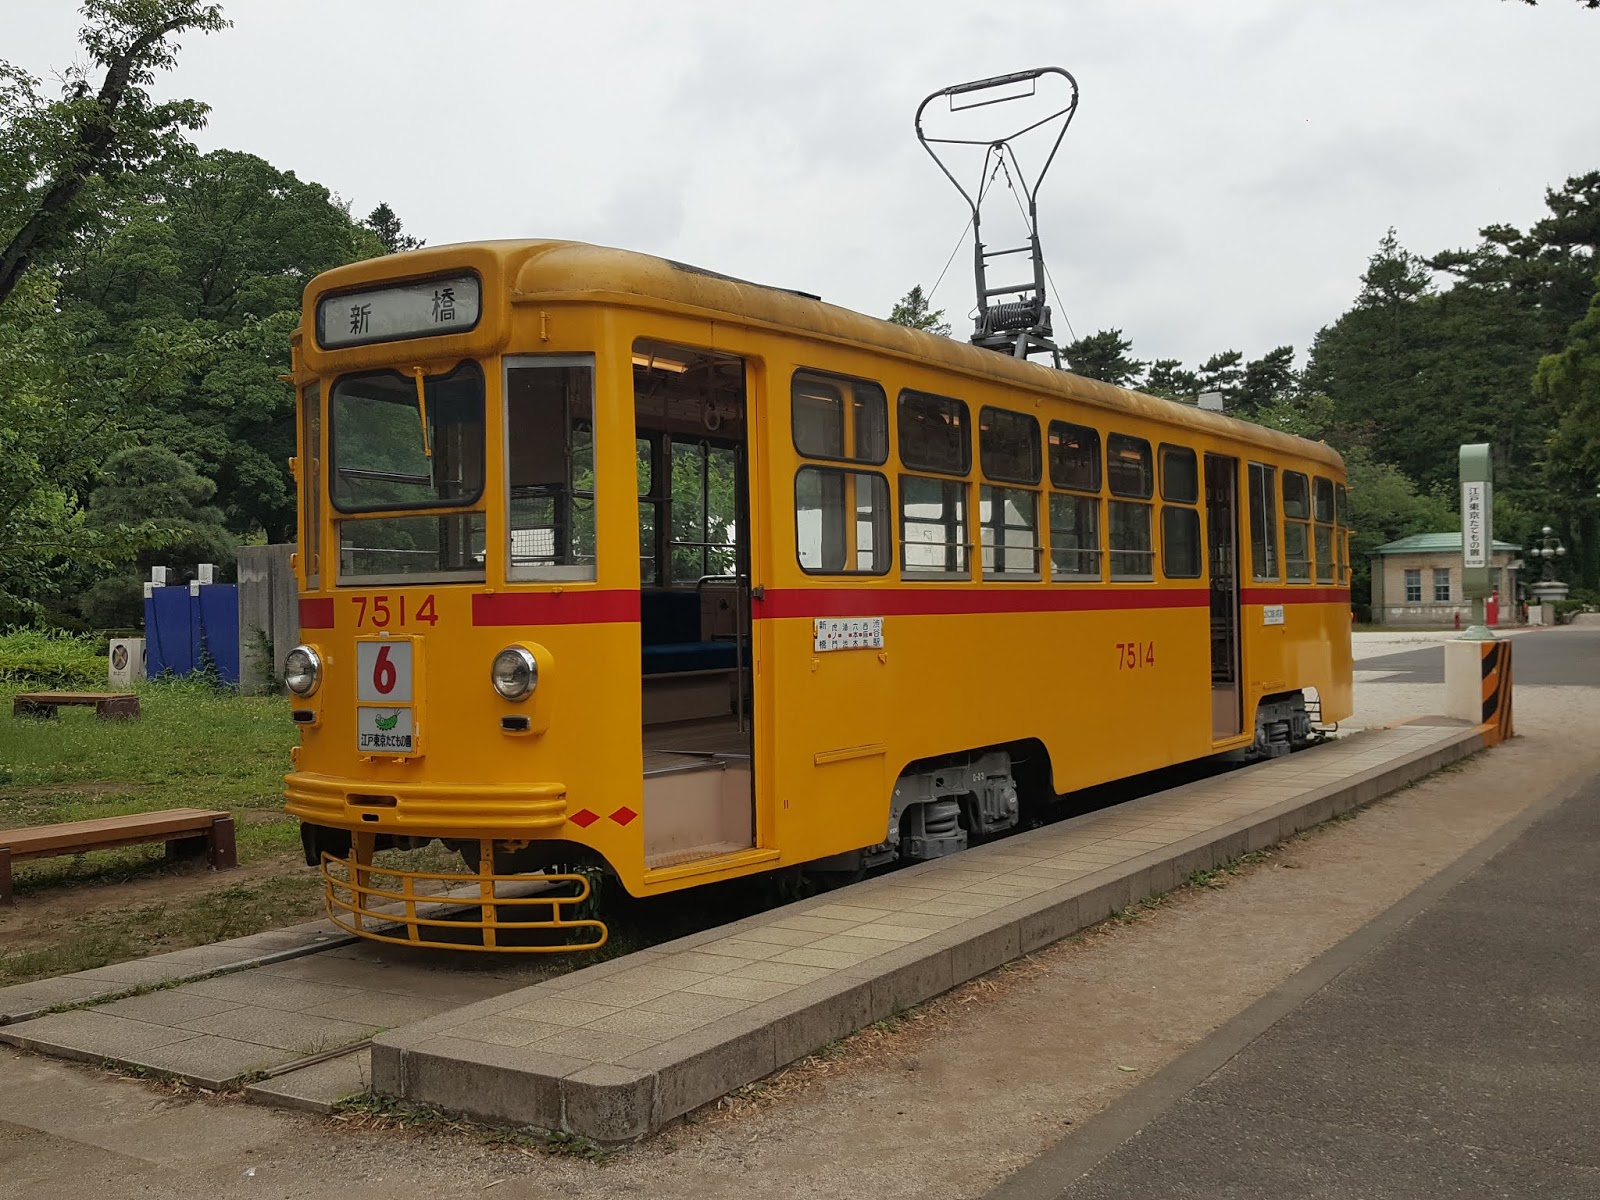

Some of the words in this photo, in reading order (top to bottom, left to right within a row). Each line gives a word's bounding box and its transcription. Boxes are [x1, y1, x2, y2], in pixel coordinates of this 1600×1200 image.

[350, 288, 455, 335] 新橋
[352, 594, 439, 628] 7514
[373, 646, 397, 695] 6
[1116, 641, 1155, 670] 7514
[361, 733, 412, 748] 江戸東京たてもの園
